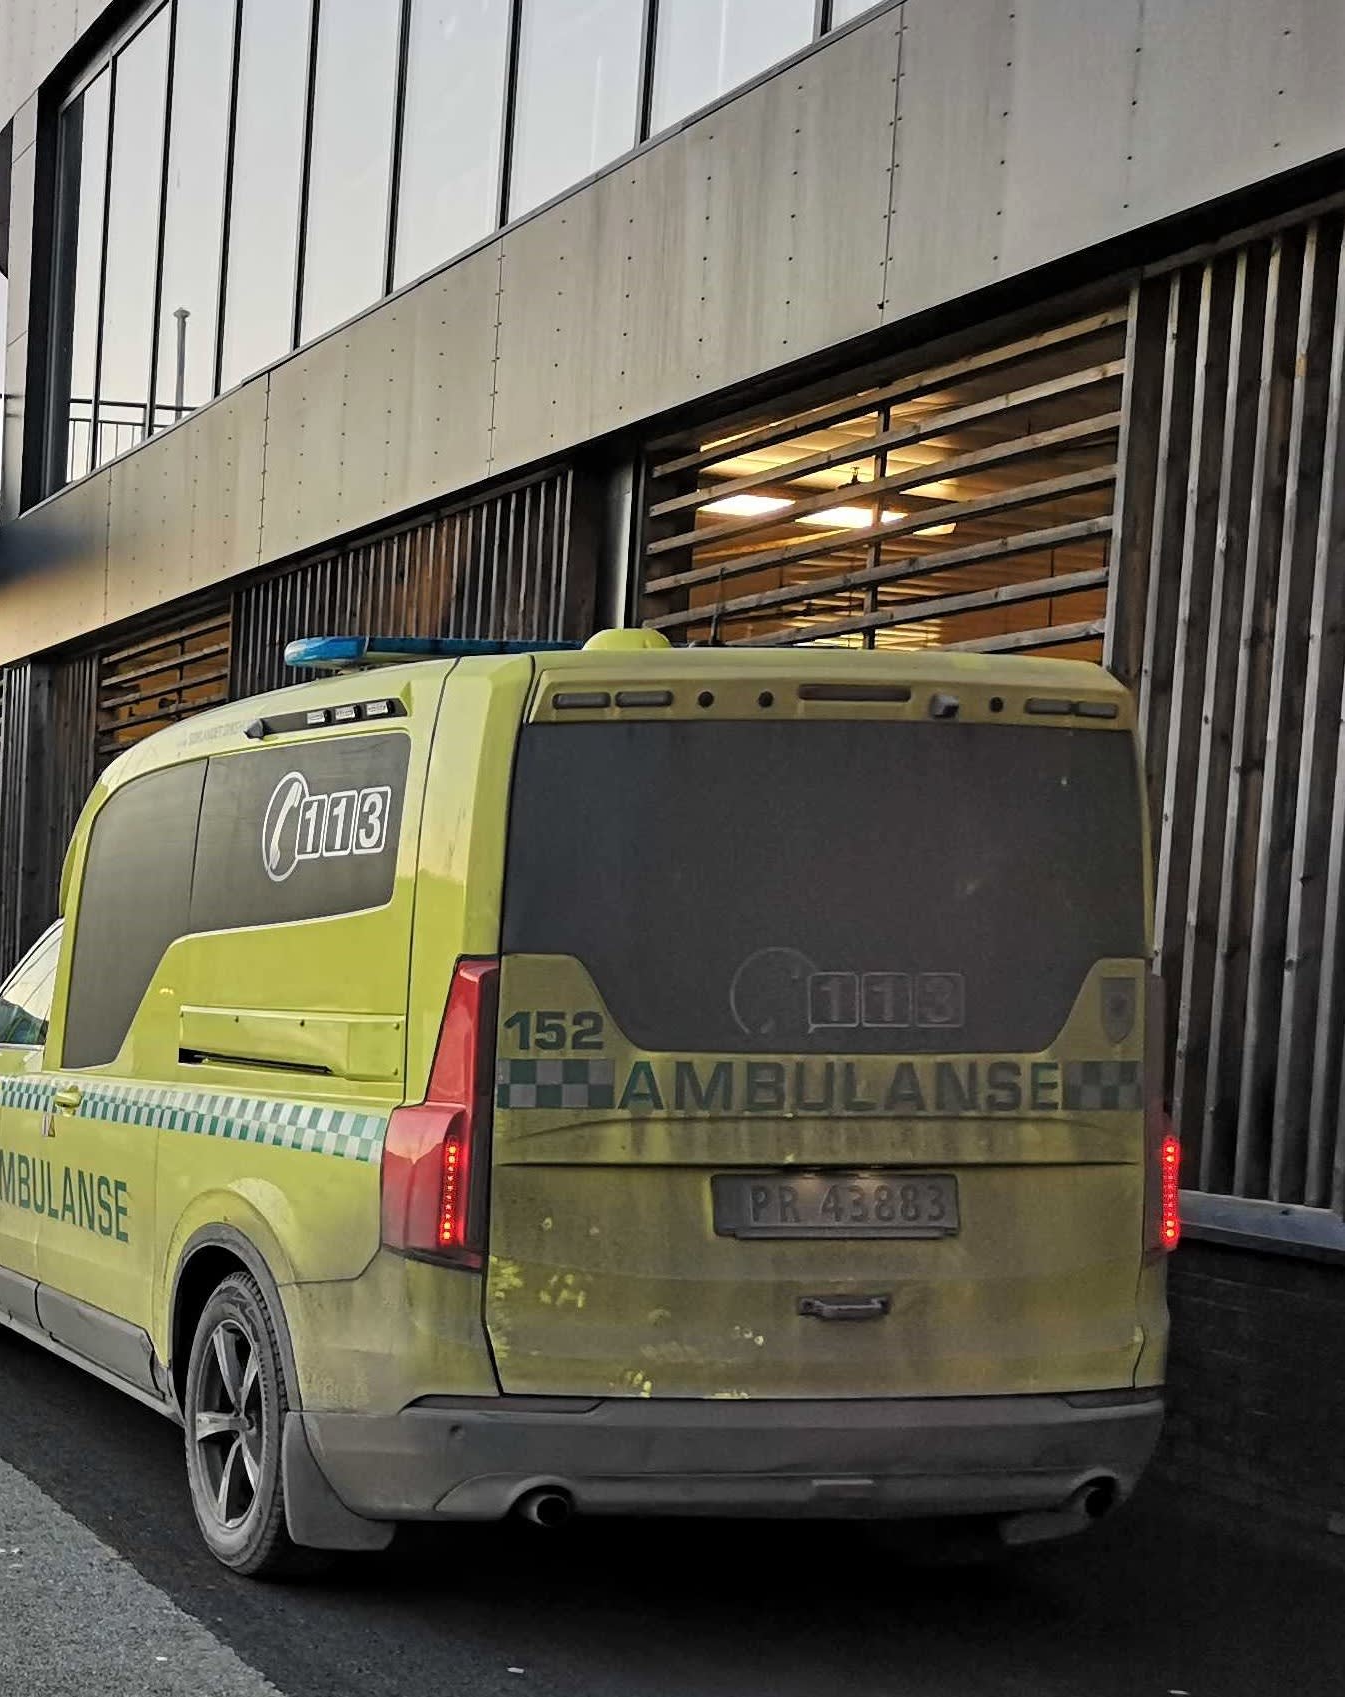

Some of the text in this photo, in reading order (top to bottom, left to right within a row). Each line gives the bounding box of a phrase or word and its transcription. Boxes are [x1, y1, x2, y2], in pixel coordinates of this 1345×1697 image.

[304, 793, 384, 853] 113
[820, 976, 953, 1023] 113
[503, 1011, 604, 1050] 152
[618, 1060, 1060, 1111] AMBULANSE
[751, 1184, 946, 1223] PR 43883
